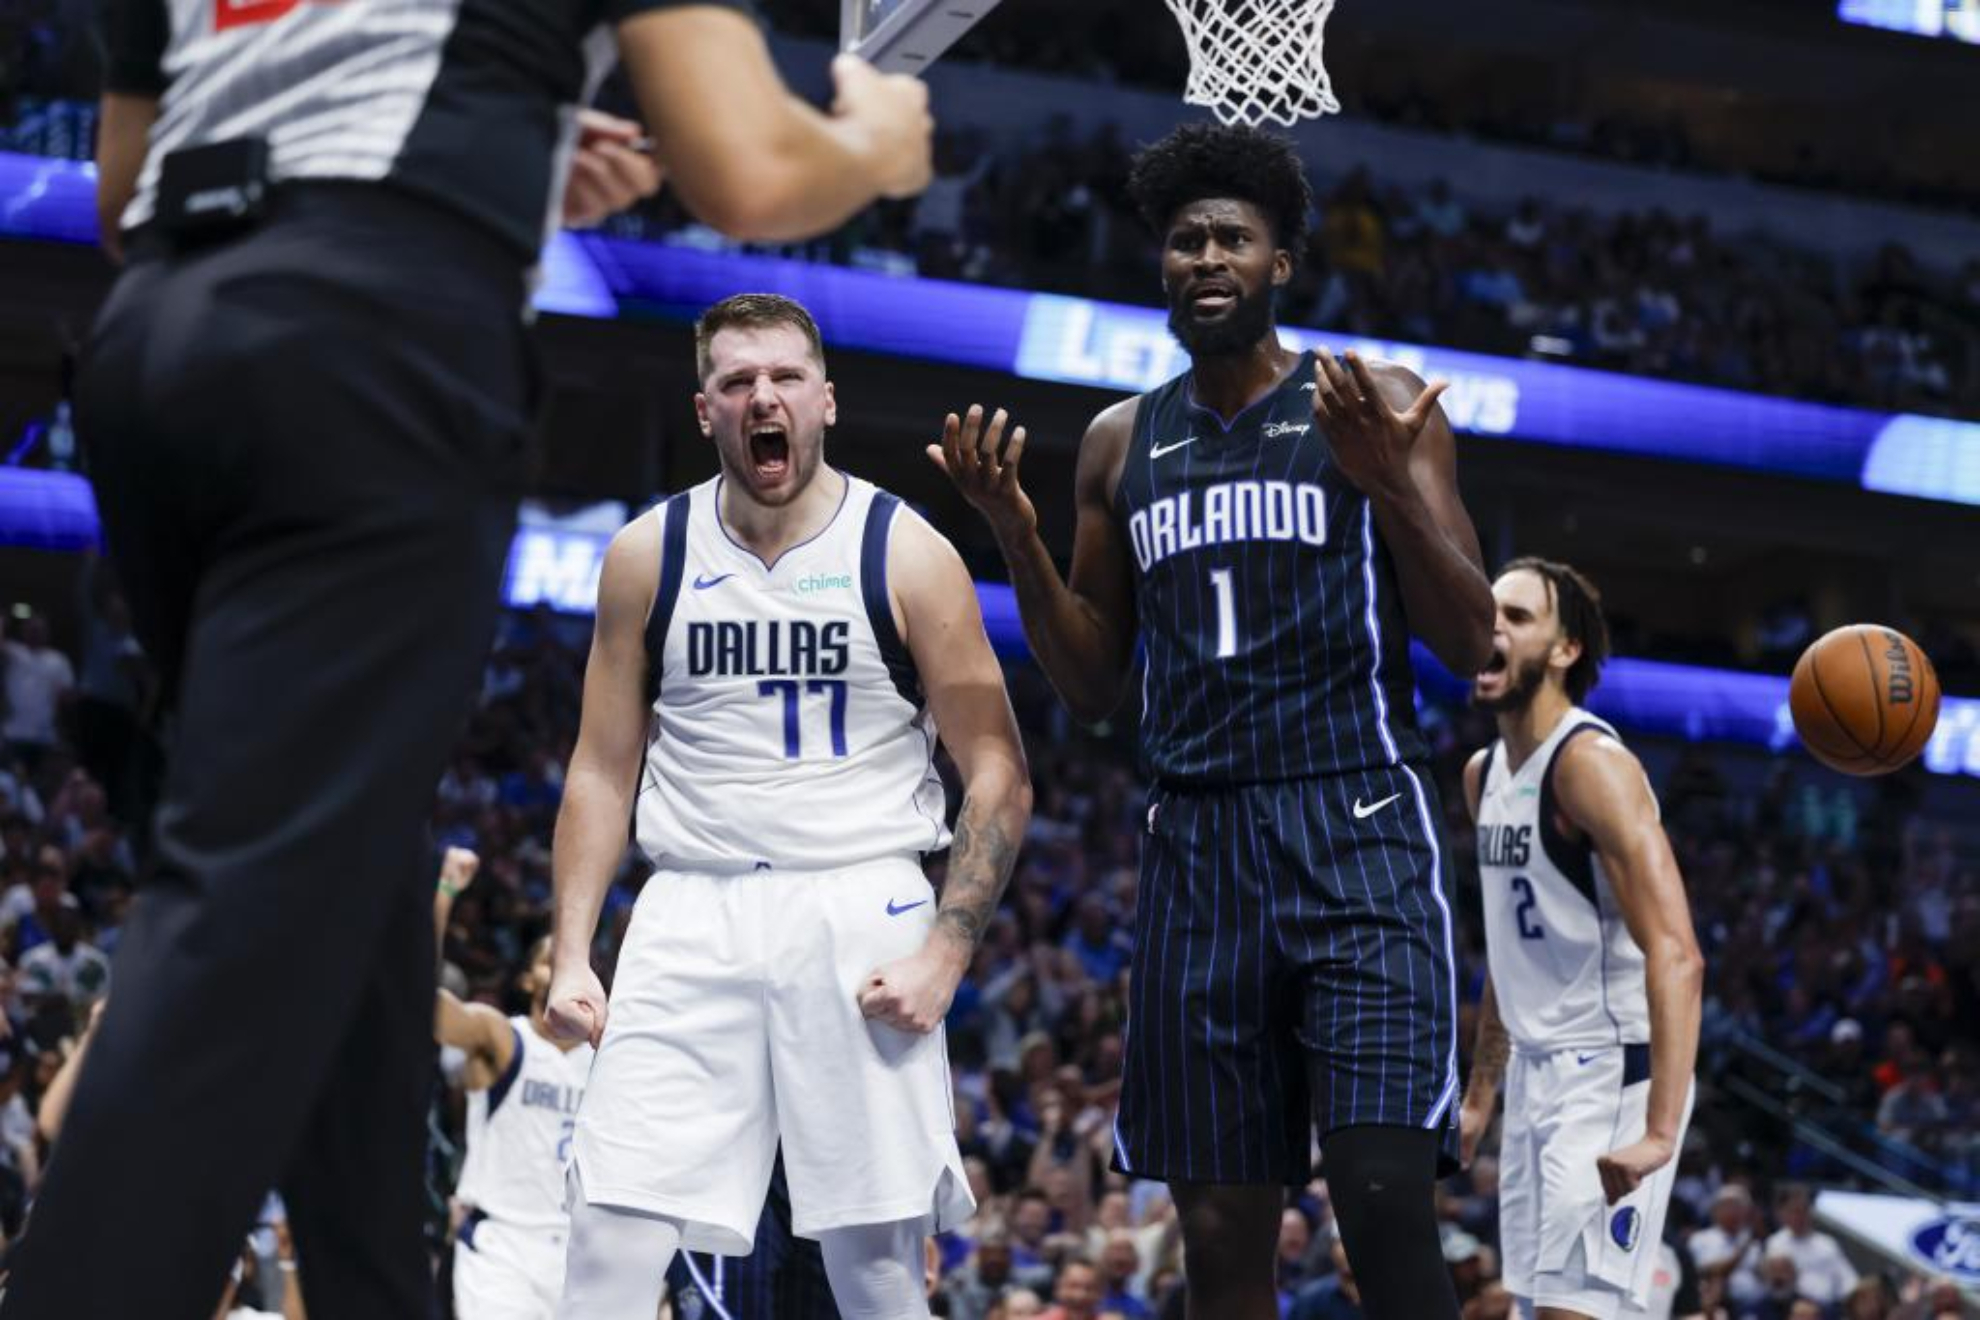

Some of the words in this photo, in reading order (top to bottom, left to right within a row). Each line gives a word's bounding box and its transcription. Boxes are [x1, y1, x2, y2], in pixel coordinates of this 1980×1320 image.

[1262, 421, 1311, 437] Disney
[1129, 480, 1326, 573] ORLANDO
[798, 573, 852, 591] chime
[1209, 568, 1237, 659] 1
[687, 620, 850, 677] DALLAS
[757, 679, 849, 759] 77
[1511, 876, 1545, 940] 2
